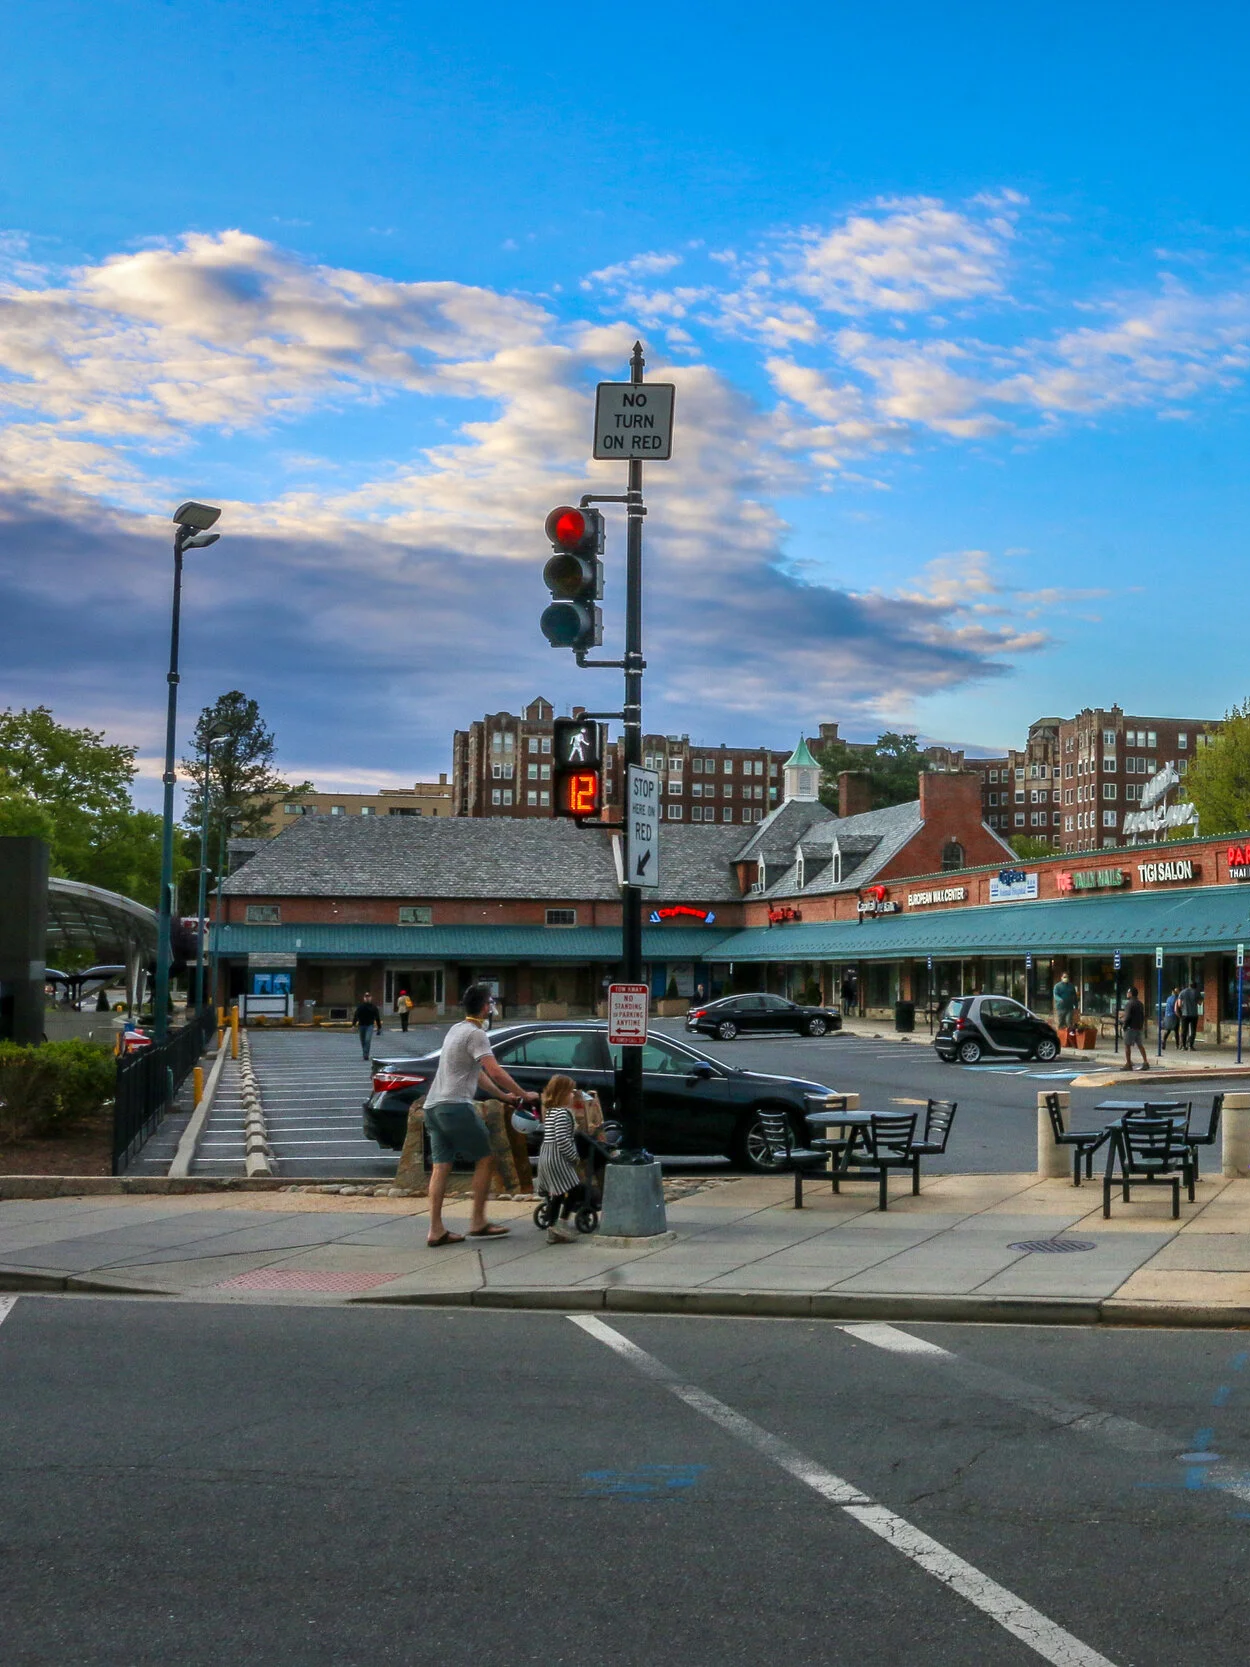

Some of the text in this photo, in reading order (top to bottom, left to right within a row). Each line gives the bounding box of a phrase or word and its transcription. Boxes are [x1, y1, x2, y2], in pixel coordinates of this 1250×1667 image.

[622, 393, 647, 407] NO
[614, 414, 655, 428] TURN
[603, 436, 662, 450] ON RED
[633, 777, 654, 798] STOP
[632, 803, 656, 817] HERE ON
[635, 822, 652, 841] RED
[1097, 867, 1123, 886] NAILS
[1137, 860, 1192, 883] TIGI SALON
[1229, 868, 1247, 878] THAI
[908, 891, 932, 906] EUROPEAN
[944, 887, 964, 902] CENTER
